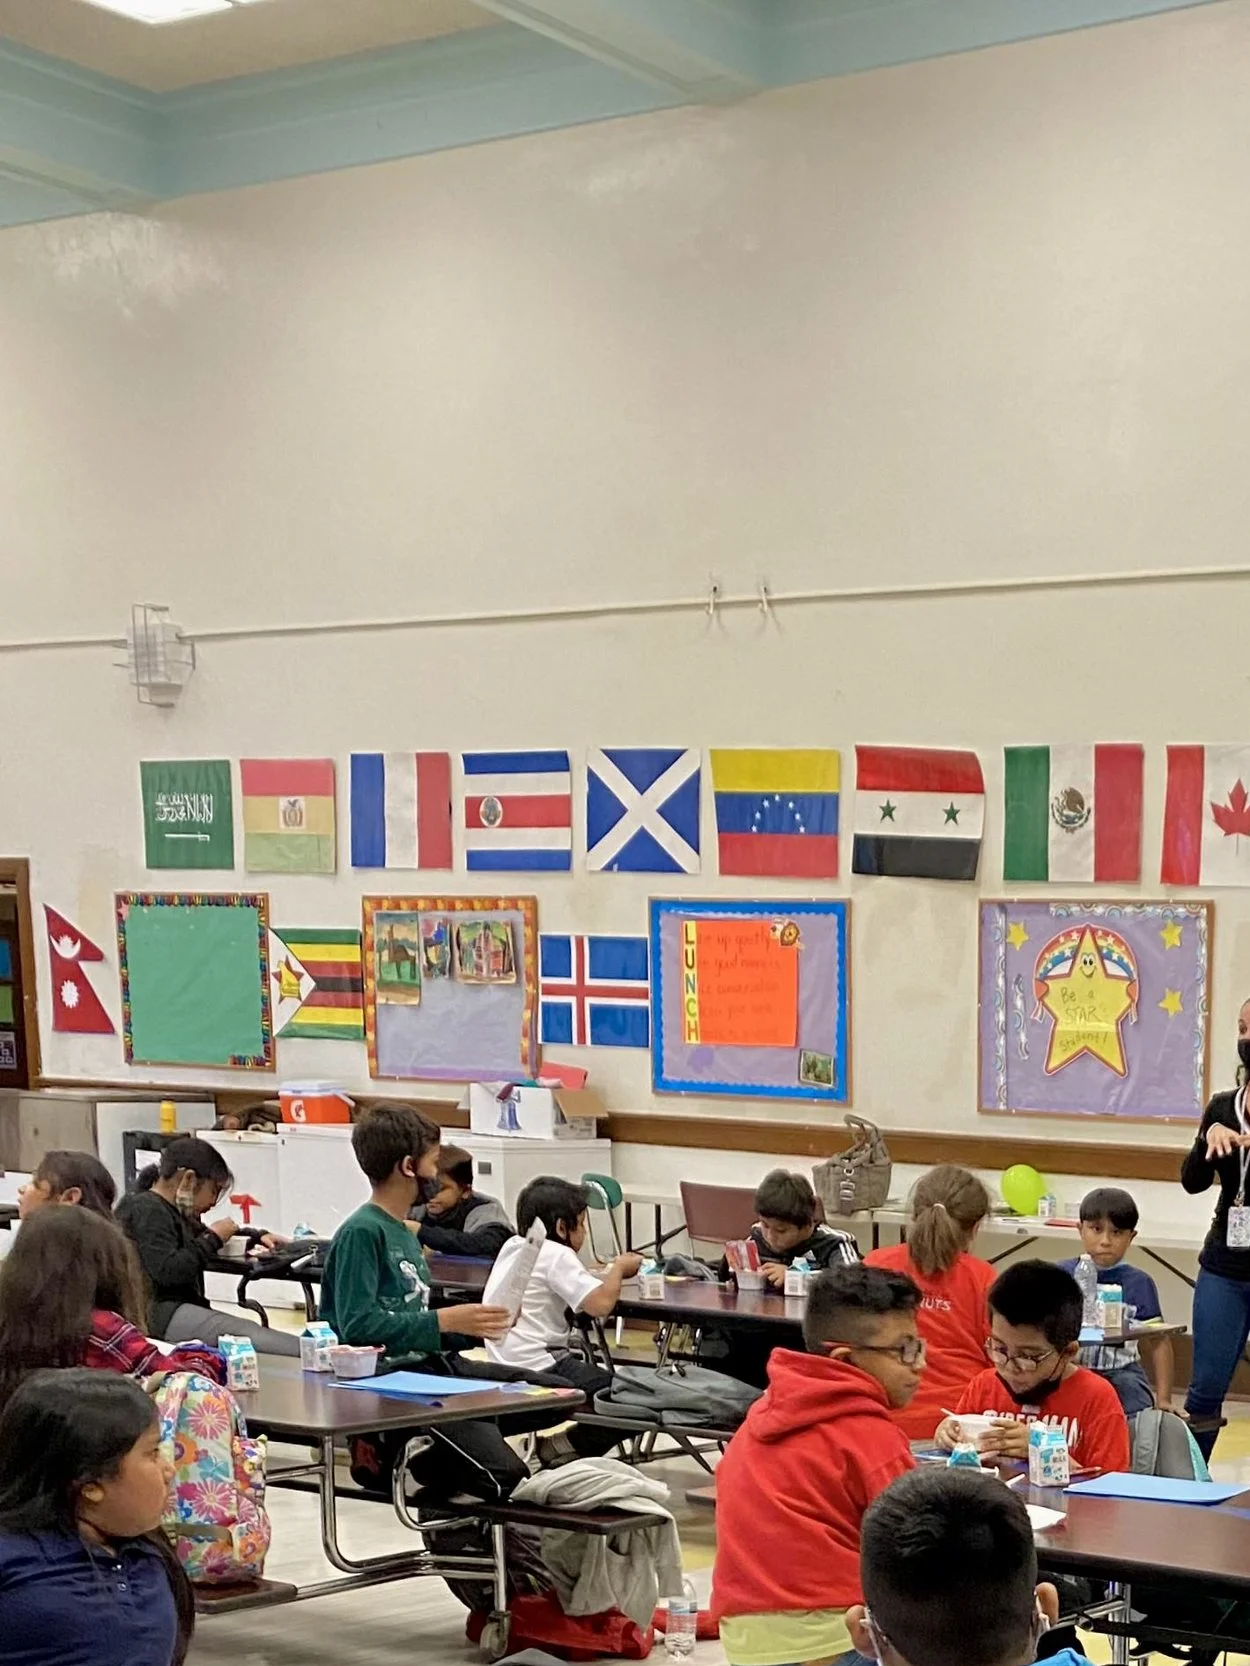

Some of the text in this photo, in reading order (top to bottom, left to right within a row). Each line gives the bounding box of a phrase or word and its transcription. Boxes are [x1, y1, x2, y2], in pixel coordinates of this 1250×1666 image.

[685, 923, 699, 1041] LUNCH
[1061, 986, 1076, 1004] Be
[1065, 1005, 1106, 1025] STAR
[290, 1099, 307, 1122] G
